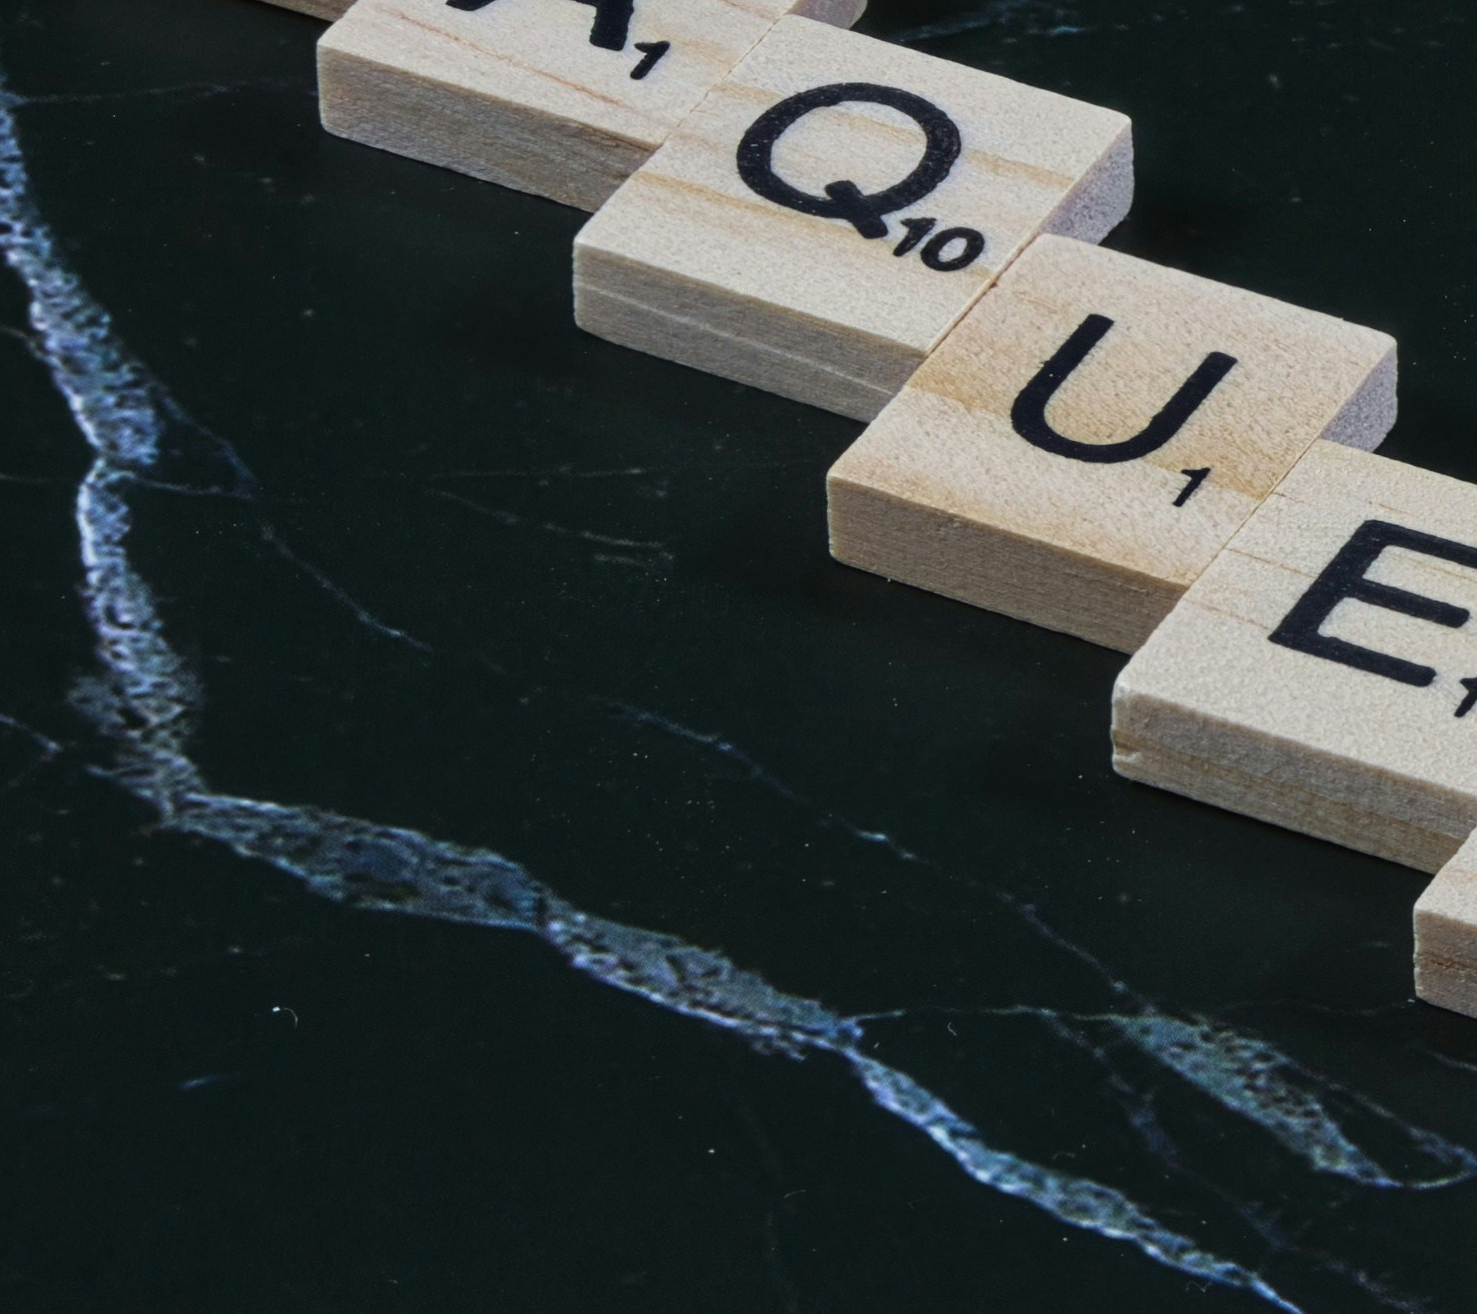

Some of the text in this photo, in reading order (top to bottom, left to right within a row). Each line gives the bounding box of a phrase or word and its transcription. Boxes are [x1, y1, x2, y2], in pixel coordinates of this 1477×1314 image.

[631, 41, 671, 80] 1
[893, 218, 985, 272] 10
[1173, 468, 1211, 508] 1
